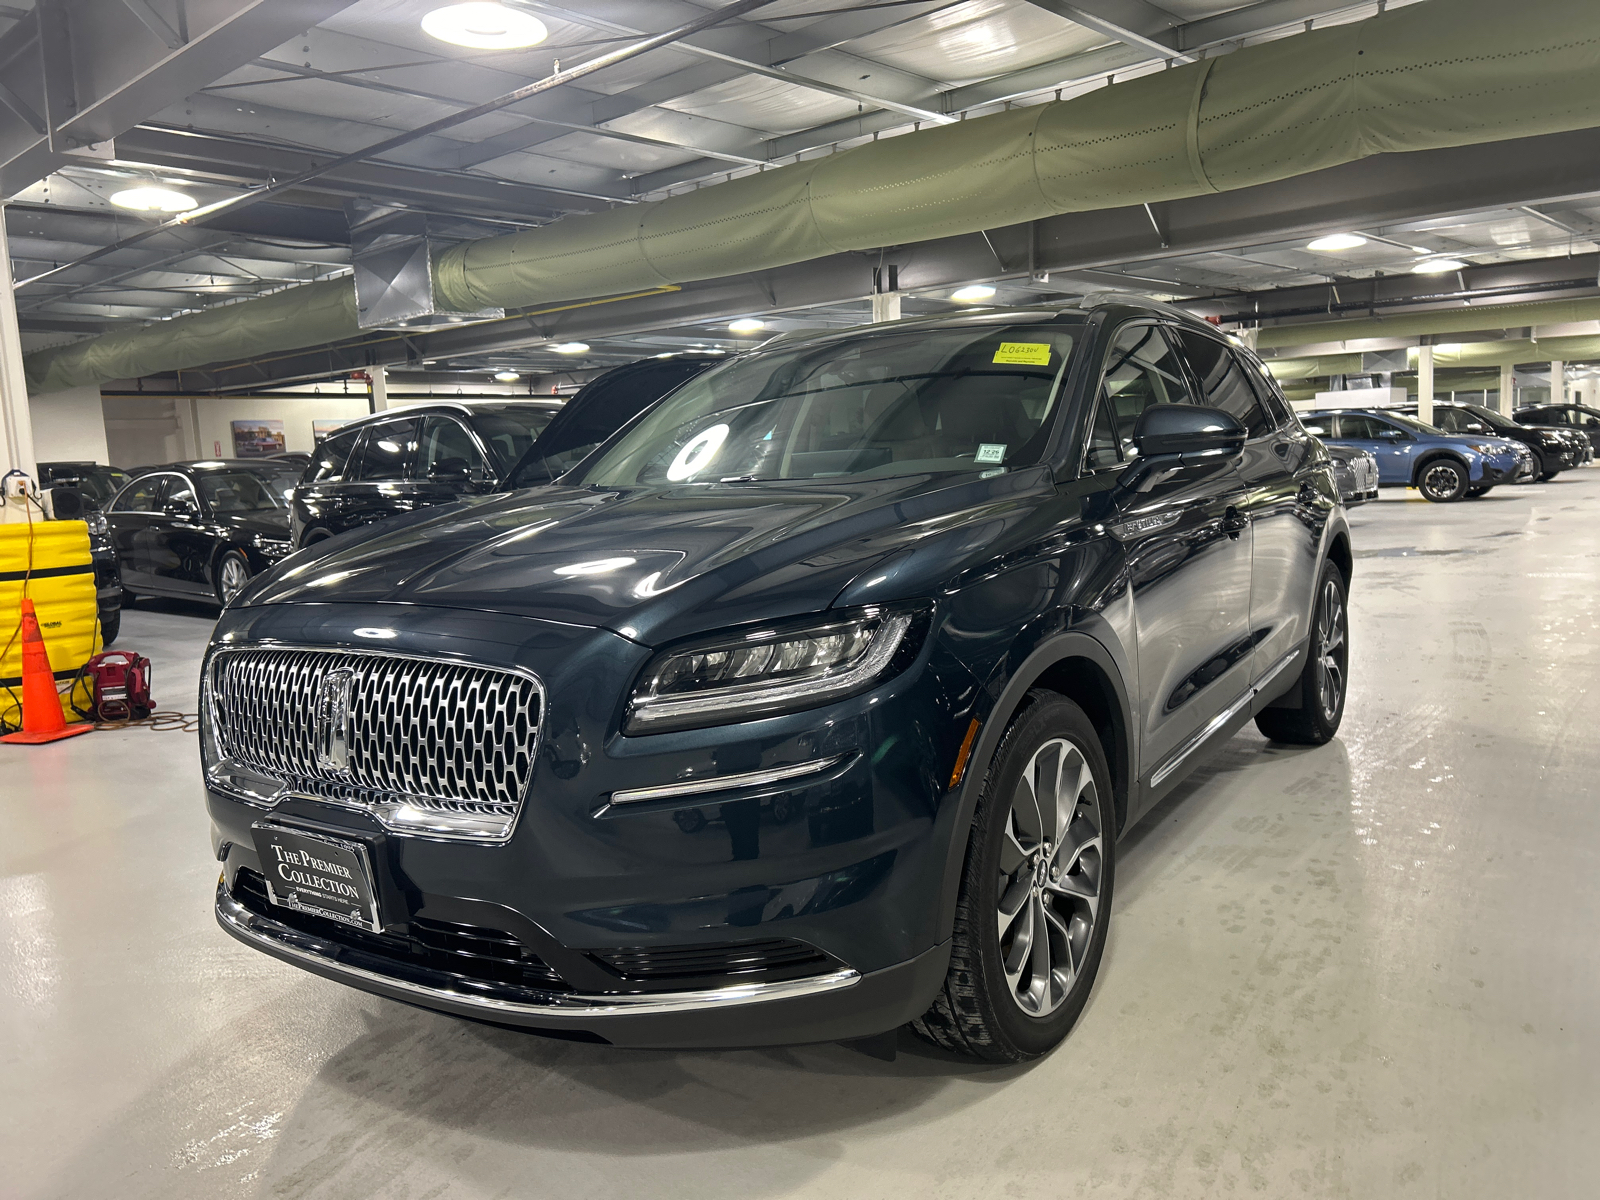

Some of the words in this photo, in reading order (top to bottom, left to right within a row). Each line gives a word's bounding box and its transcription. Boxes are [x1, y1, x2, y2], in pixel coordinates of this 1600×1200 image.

[271, 844, 302, 866] THE
[299, 849, 353, 880] PREMIER
[278, 863, 360, 899] COLLECTION
[295, 886, 322, 898] EVERYTHING
